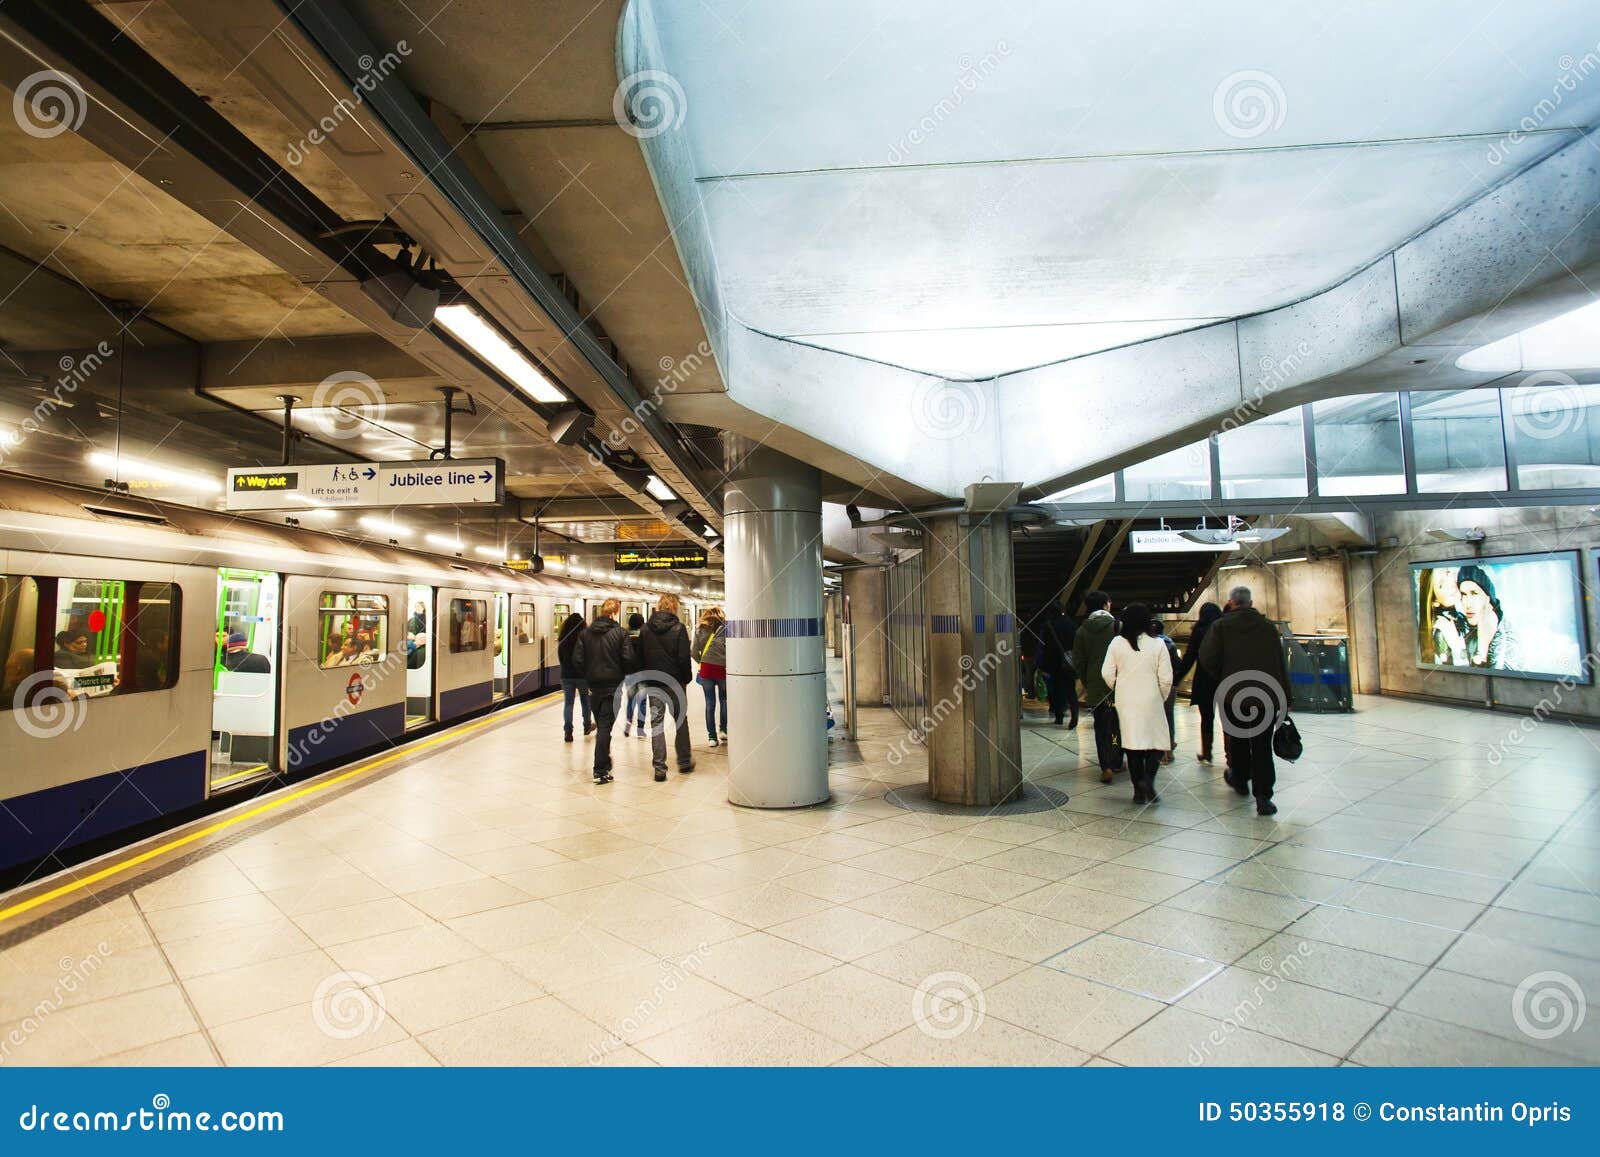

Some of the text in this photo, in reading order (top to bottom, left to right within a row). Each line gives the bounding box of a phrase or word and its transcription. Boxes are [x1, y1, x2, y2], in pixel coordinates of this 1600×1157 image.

[246, 476, 287, 488] Way out
[389, 471, 476, 487] Jubilee line
[311, 487, 325, 495] Lift
[337, 487, 350, 495] exit
[353, 486, 360, 494] &
